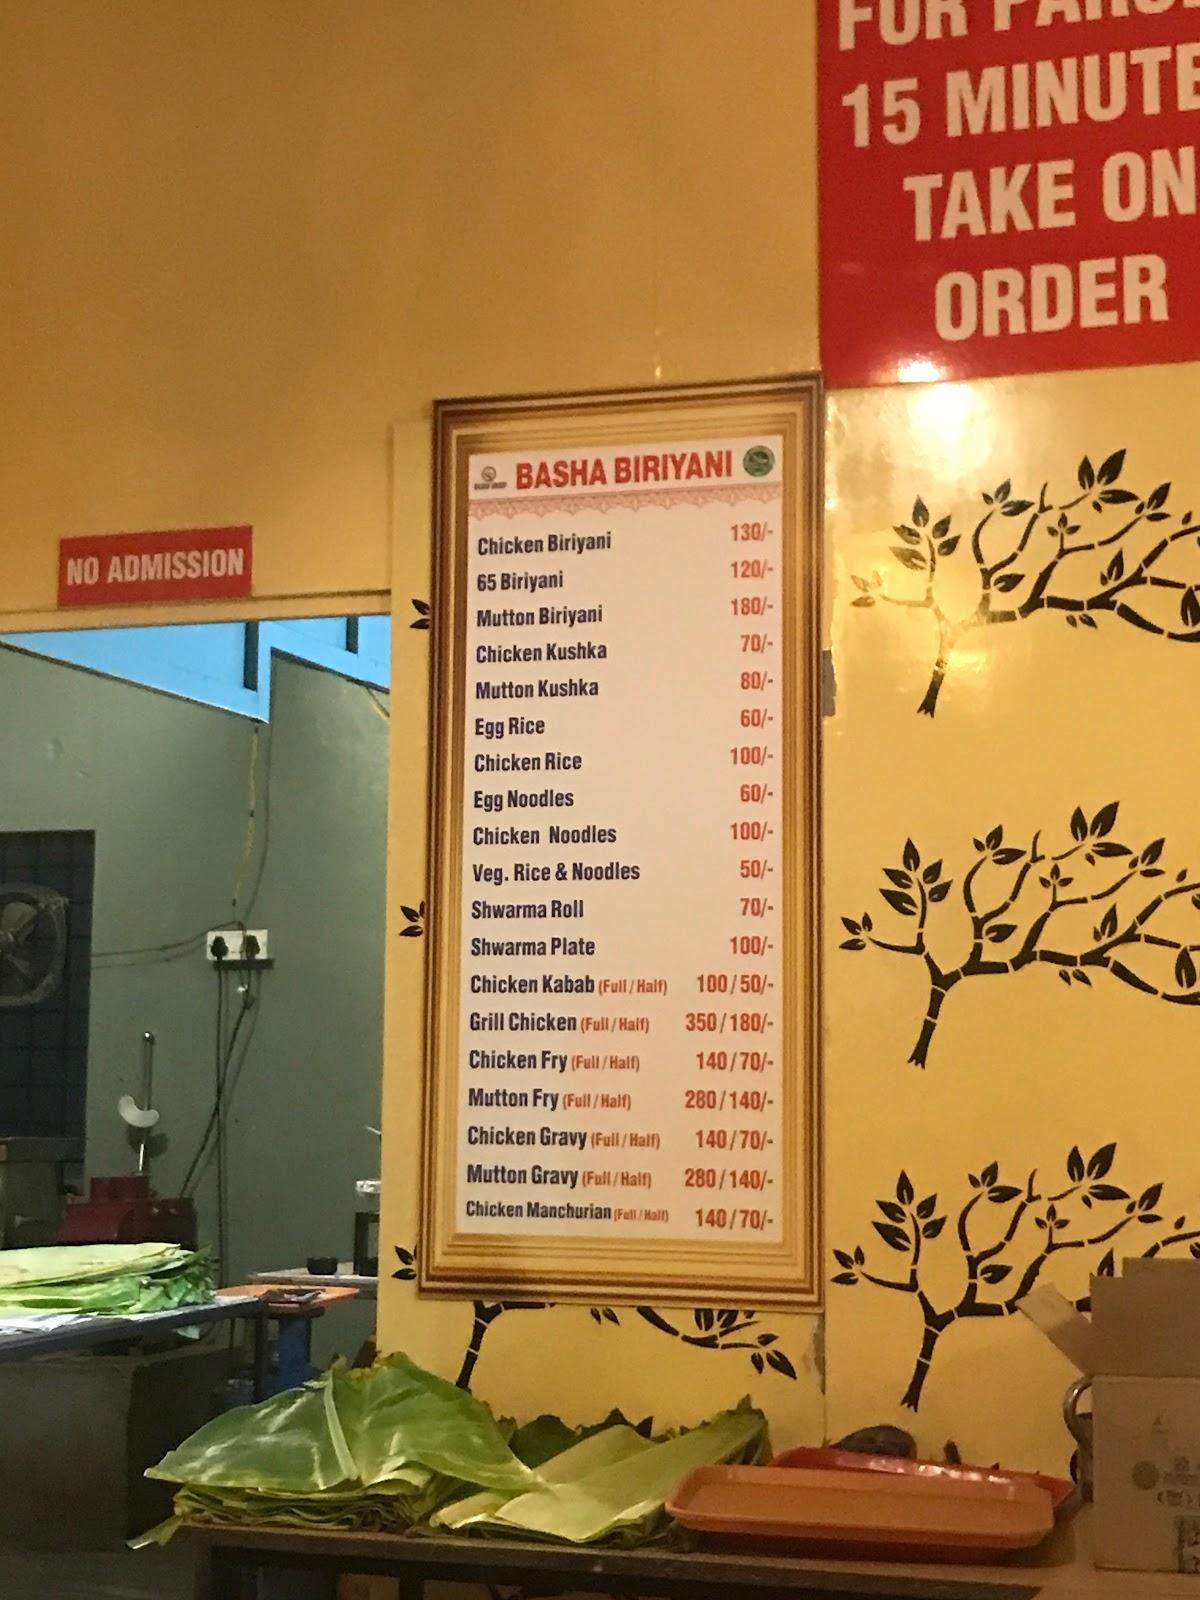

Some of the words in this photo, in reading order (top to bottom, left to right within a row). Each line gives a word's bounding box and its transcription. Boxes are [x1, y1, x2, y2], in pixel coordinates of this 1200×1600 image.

[842, 77, 921, 148] 15
[946, 42, 1200, 138] MINUTE
[902, 159, 1076, 242] TAKE
[935, 254, 1169, 342] ORDER
[516, 459, 607, 490] BASHA
[614, 450, 733, 484] BIRIYANI
[478, 536, 543, 556] Chicken
[548, 532, 611, 554] Biriyani
[67, 556, 99, 585] NO
[106, 548, 244, 583] ADMISSION
[477, 574, 496, 591] 65
[500, 571, 563, 593] Biriyani
[477, 609, 534, 627] Mutton
[539, 605, 603, 628] Biriyani
[476, 644, 542, 664] Chicken
[546, 641, 607, 661] Kushka
[476, 680, 534, 699] Mutton
[538, 678, 599, 698] Kushka
[475, 718, 504, 739] Egg
[509, 717, 545, 735] Rice
[474, 753, 540, 772] Chicken
[545, 752, 582, 771] Rice
[473, 791, 503, 812] Egg
[507, 789, 574, 808] Noodles
[473, 827, 539, 845] Chicken
[549, 825, 616, 844] Noodles
[473, 864, 509, 886] Veg.
[514, 863, 551, 881] Rice
[555, 863, 567, 880] &
[572, 862, 640, 880] Noodles
[471, 900, 547, 919] Shwarma
[551, 900, 584, 918] Roll
[471, 937, 547, 956] Shwarma
[551, 937, 595, 956] Plate
[471, 975, 538, 994] Chicken
[543, 975, 595, 994] Kabab
[470, 1013, 505, 1032] Grill
[509, 1013, 577, 1032] Chicken
[469, 1050, 537, 1069] Chicken
[541, 1050, 568, 1072] Fry
[468, 1088, 528, 1108] Mutton
[533, 1088, 559, 1112] Fry
[467, 1126, 535, 1146] Chicken
[540, 1127, 587, 1150] Gravy
[467, 1164, 527, 1184] Mutton
[531, 1165, 578, 1189] Gravy
[466, 1201, 523, 1219] Chicken
[527, 1202, 611, 1220] Manchurian
